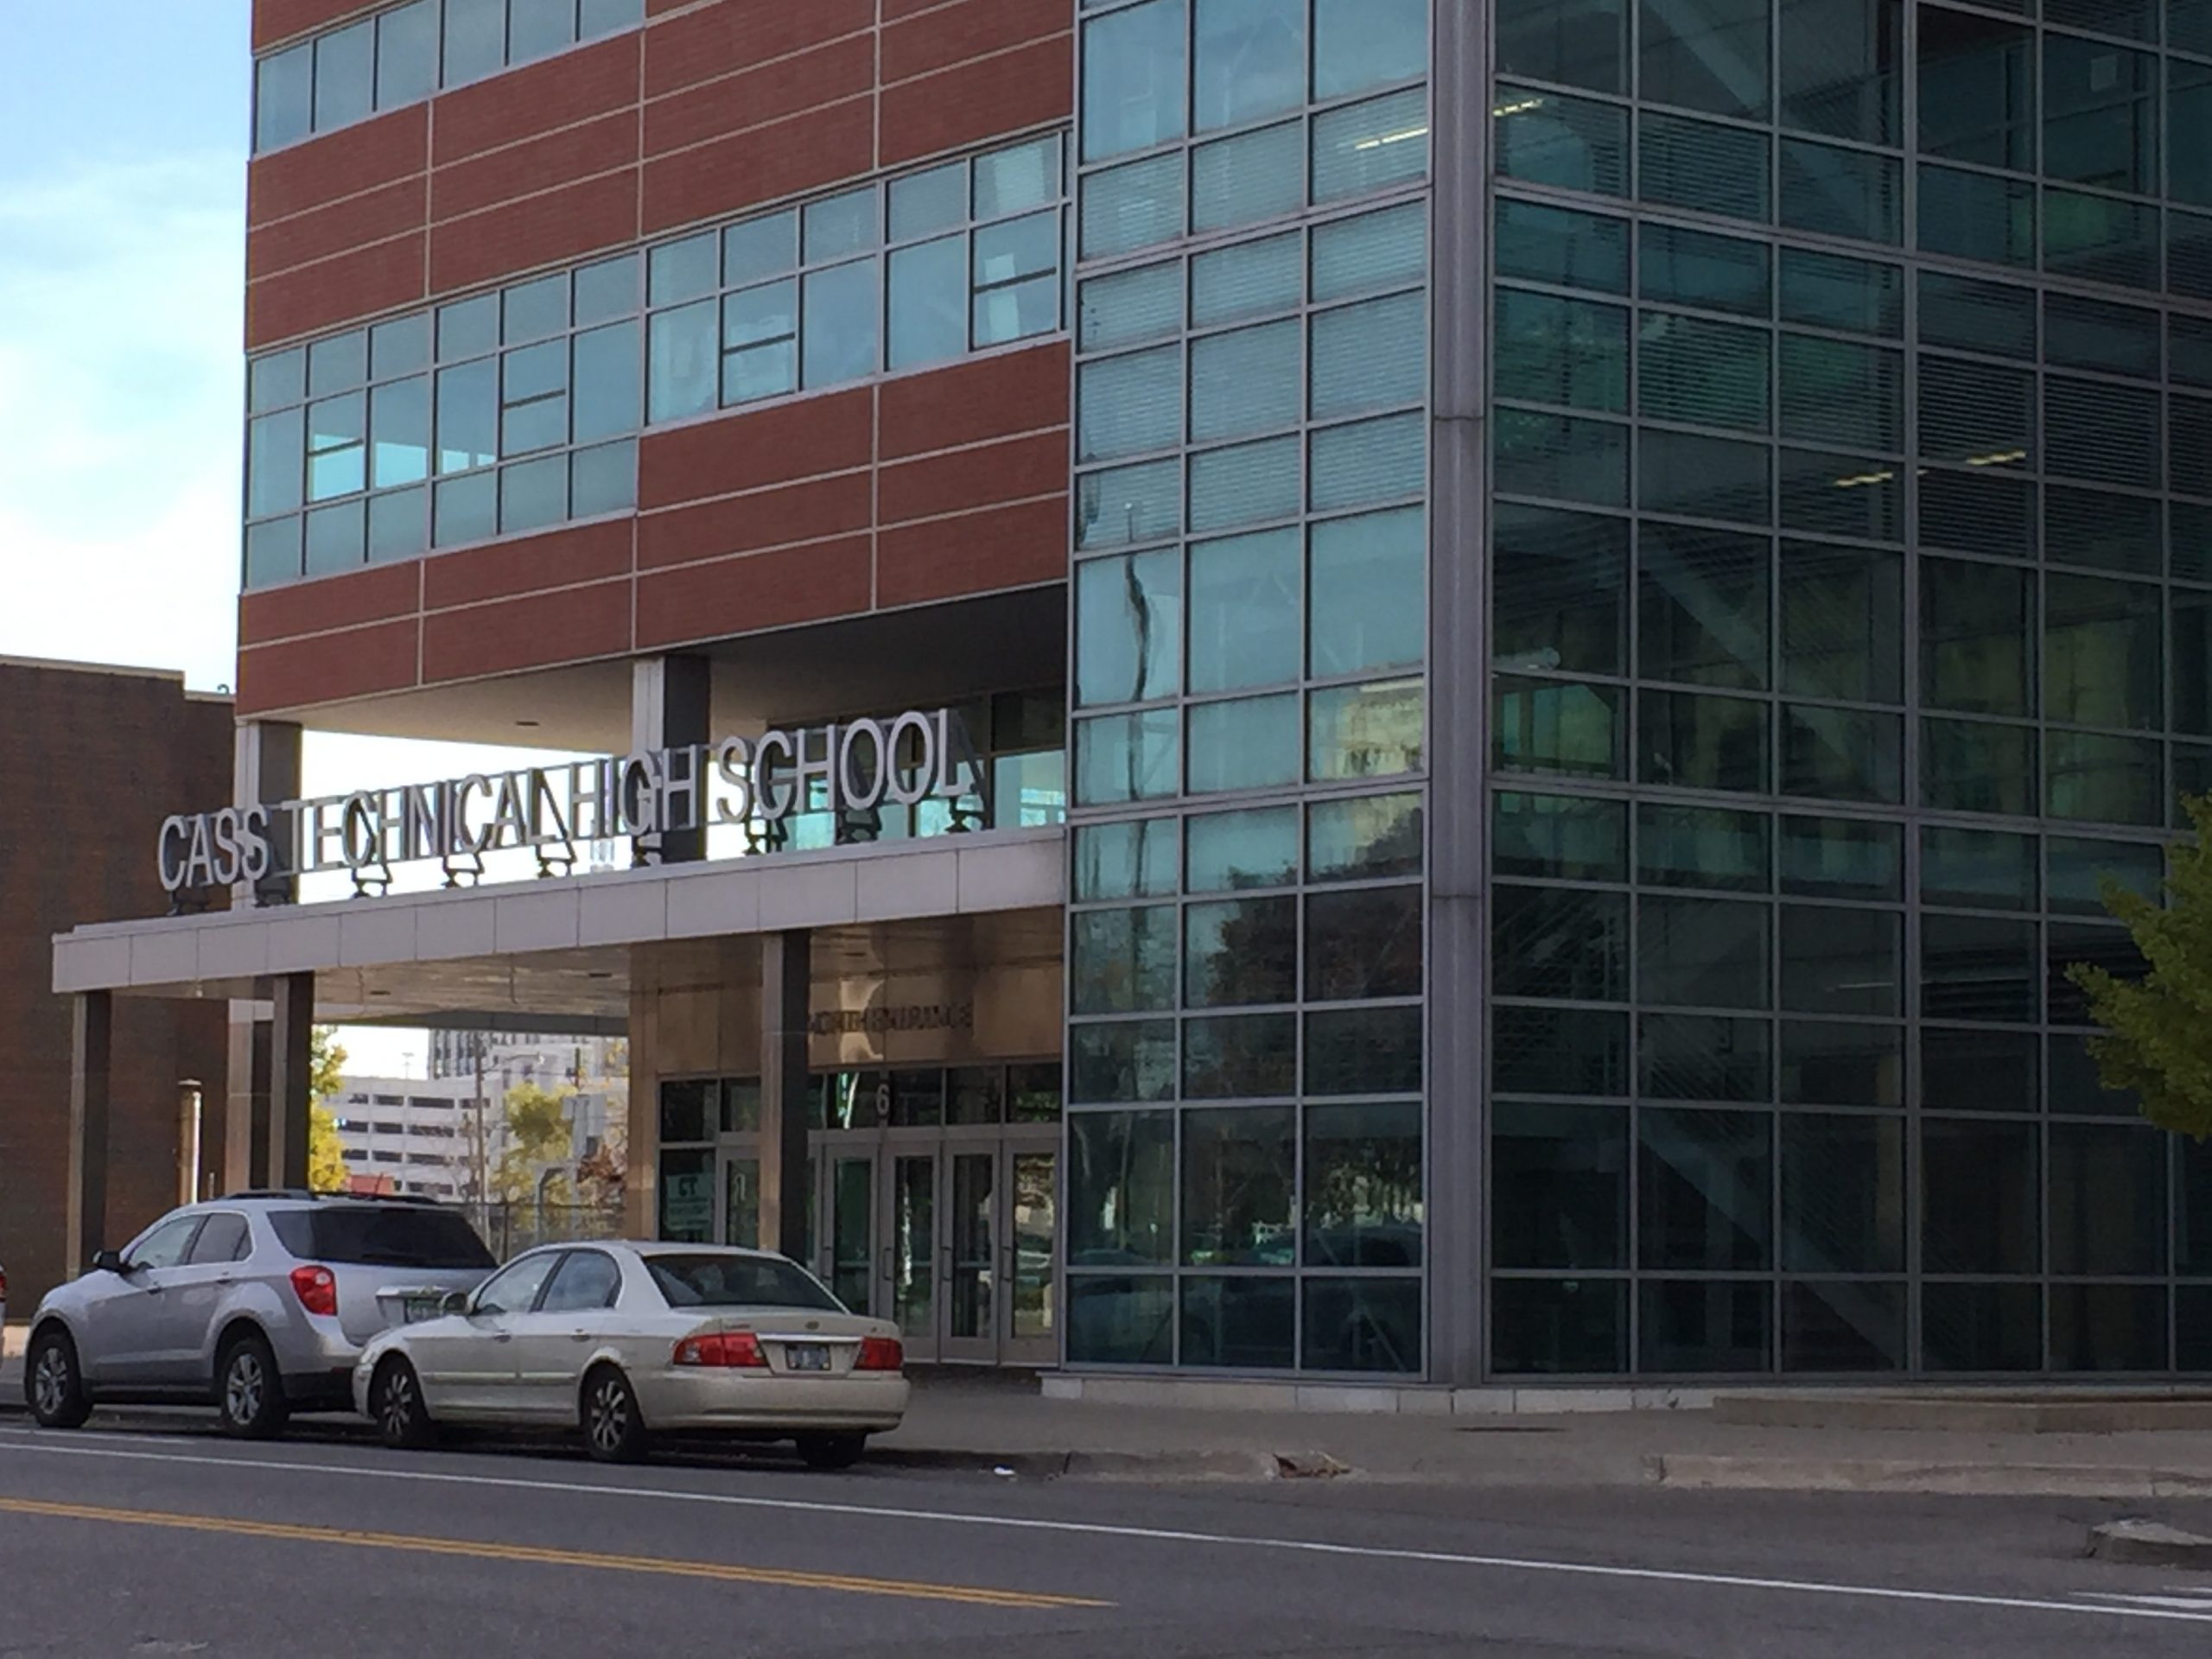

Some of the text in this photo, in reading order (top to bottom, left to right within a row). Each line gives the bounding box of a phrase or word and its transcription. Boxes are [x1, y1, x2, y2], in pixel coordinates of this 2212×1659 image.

[158, 709, 975, 891] CASS TECHNICAL HIGH SCHOOL
[876, 1084, 890, 1116] 6
